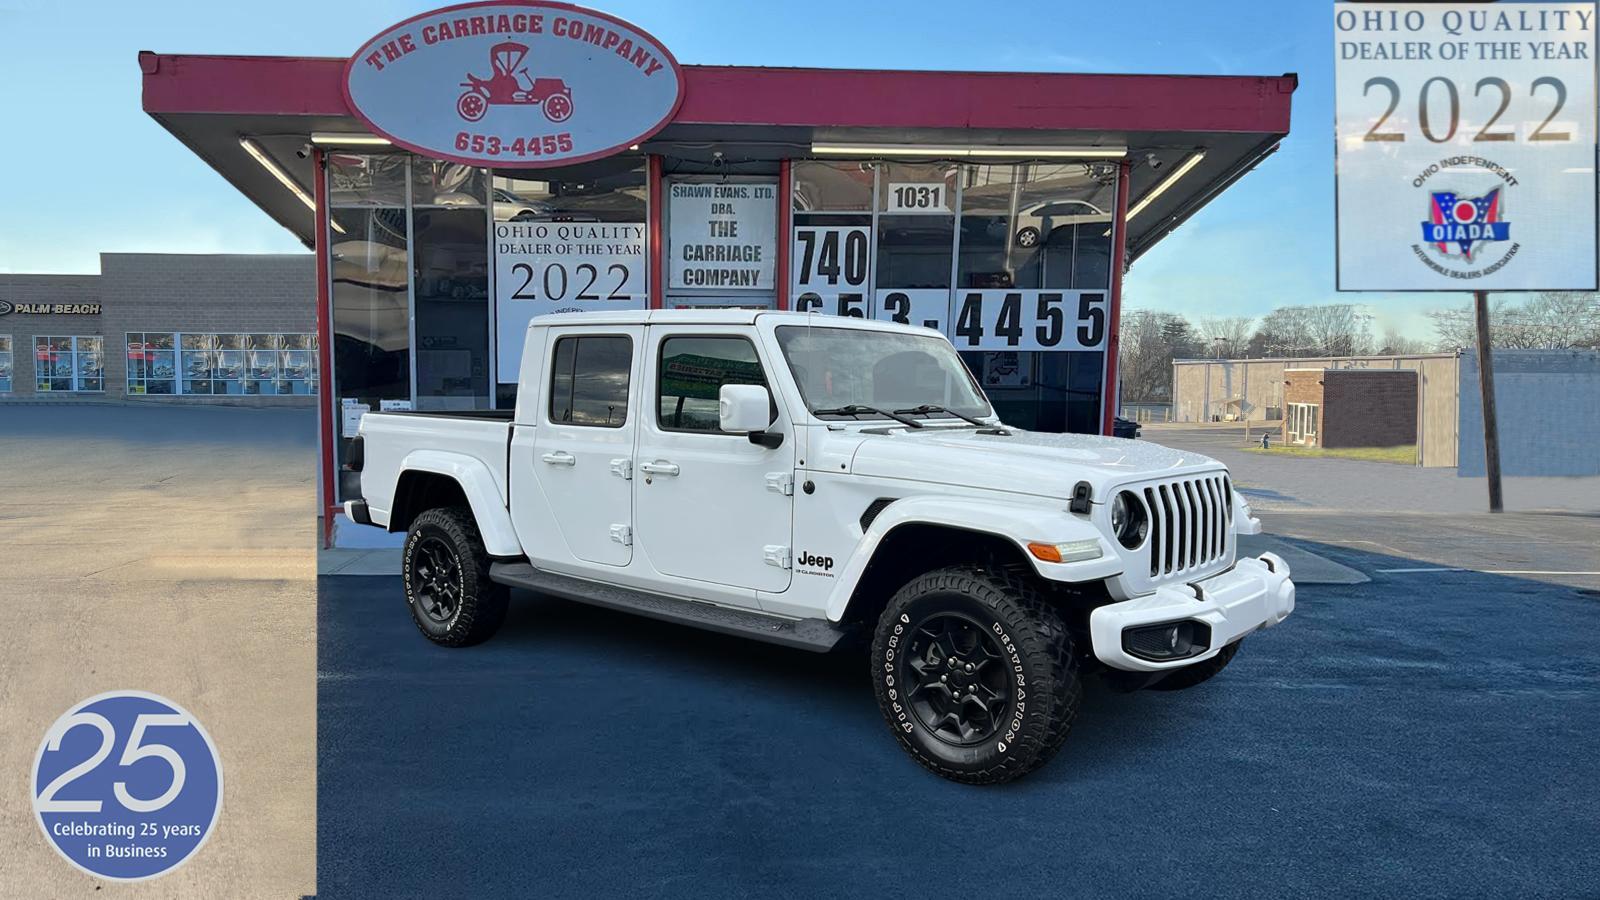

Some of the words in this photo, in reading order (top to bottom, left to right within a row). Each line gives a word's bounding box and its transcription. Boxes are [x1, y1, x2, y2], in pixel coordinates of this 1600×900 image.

[1336, 10, 1425, 31] OHIO
[1442, 10, 1593, 35] QUALITY
[366, 33, 417, 72] THE
[422, 14, 544, 46] CARRIAGE
[552, 17, 664, 77] COMPANY
[1340, 41, 1432, 60] DEALER
[1439, 41, 1470, 60] OF
[1475, 42, 1522, 60] THE
[1528, 42, 1589, 60] YEAR
[1363, 76, 1571, 143] 2022
[455, 131, 573, 156] 653-4455
[1413, 164, 1439, 188] OHIO
[1440, 156, 1519, 187] INDEPENDENT
[672, 186, 712, 198] SHAWN
[754, 187, 775, 199] LTD.
[894, 187, 940, 208] 1031
[711, 203, 736, 215] DBA.
[497, 226, 548, 239] OHIO
[558, 226, 644, 240] QUALITY
[708, 221, 738, 238] THE
[1432, 224, 1495, 240] OIADA
[500, 243, 552, 255] DEALER
[555, 243, 573, 255] OF
[576, 244, 603, 255] THE
[607, 244, 641, 255] YEAR
[683, 244, 762, 262] CARRIAGE
[797, 230, 868, 286] 740
[1411, 244, 1449, 277] AUTOMOBILE
[1449, 269, 1482, 279] DEALERS
[1482, 242, 1521, 276] ASSOCIATION
[511, 263, 631, 300] 2022
[683, 268, 760, 286] COMPANY
[14, 304, 50, 314] PALM
[55, 304, 100, 314] BEACH
[798, 551, 834, 571] Jeep
[992, 622, 1025, 744] DESTINATION
